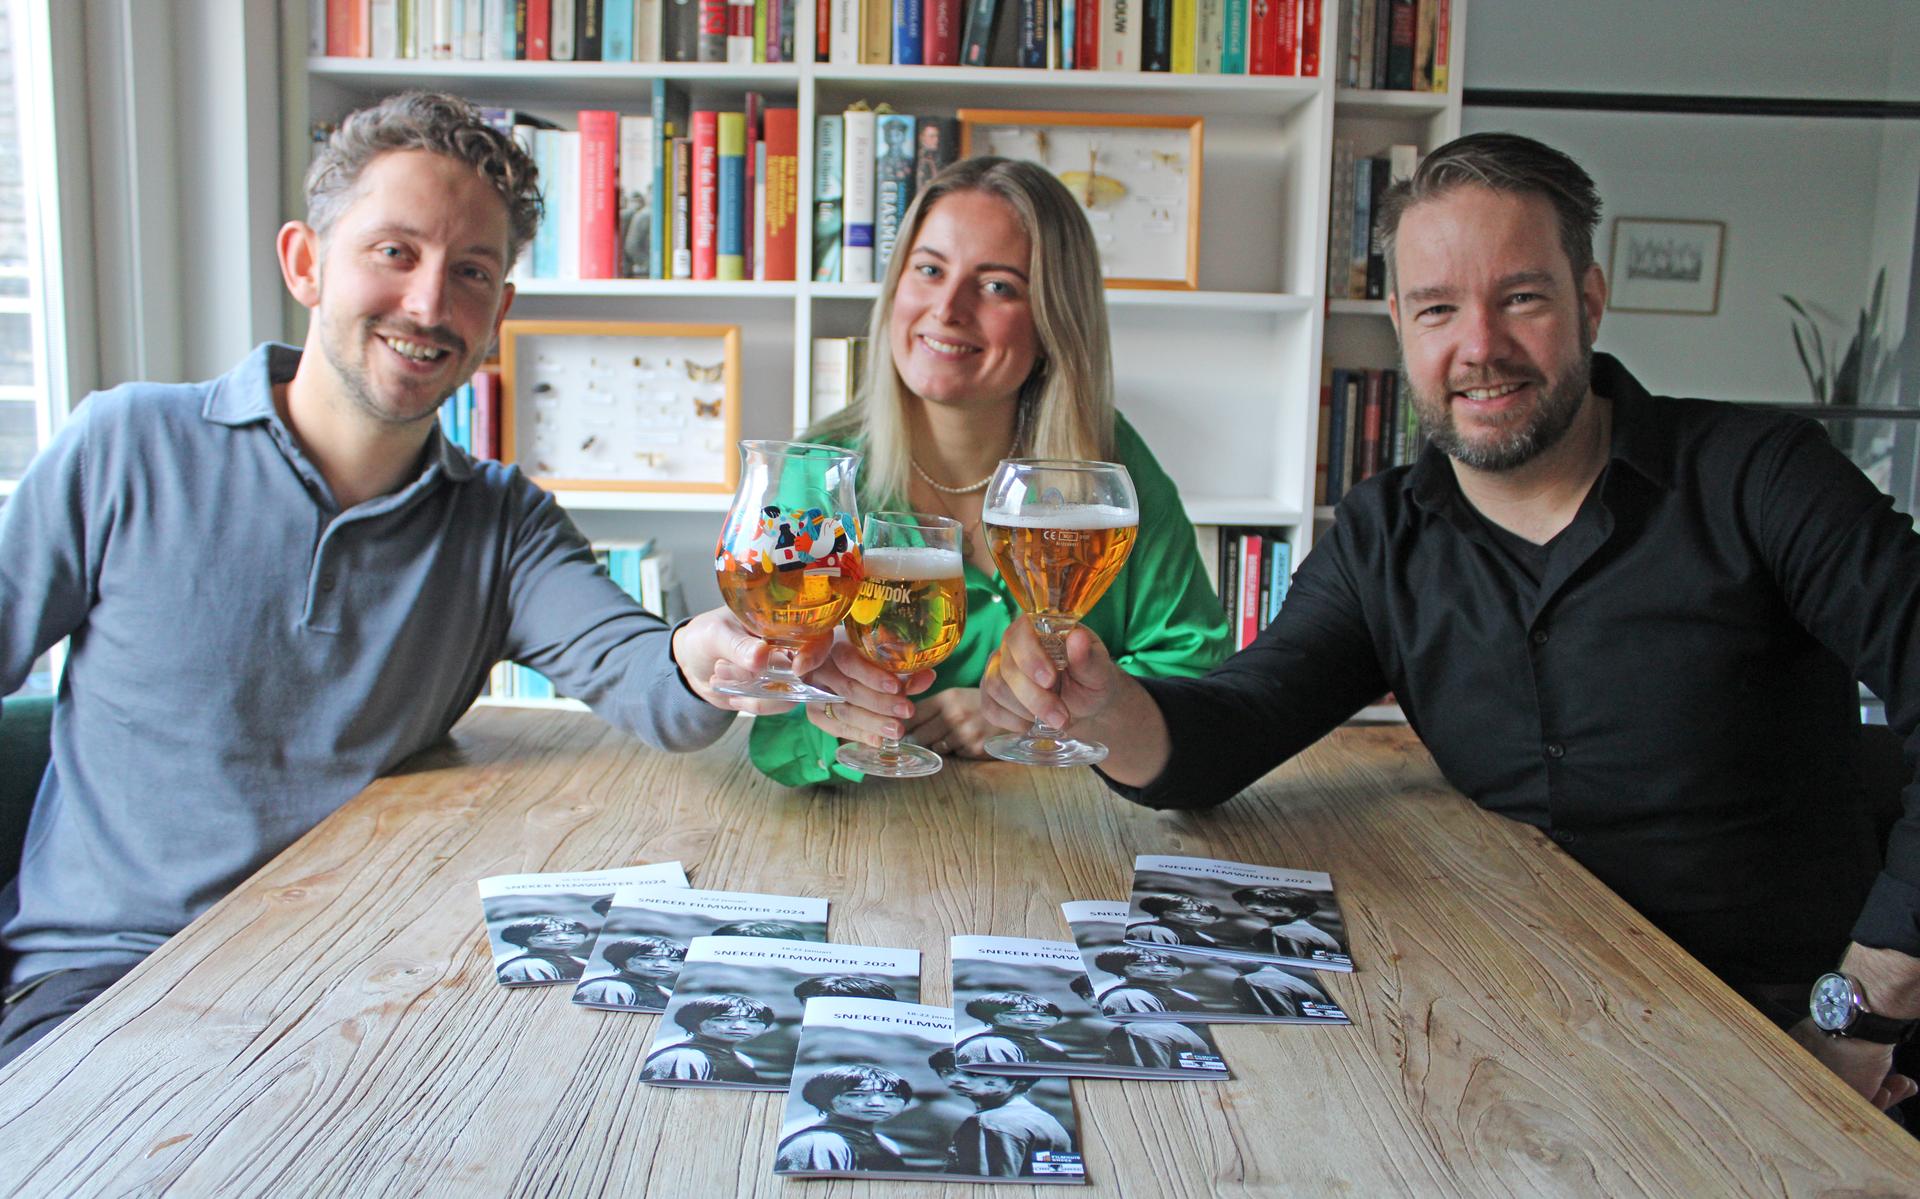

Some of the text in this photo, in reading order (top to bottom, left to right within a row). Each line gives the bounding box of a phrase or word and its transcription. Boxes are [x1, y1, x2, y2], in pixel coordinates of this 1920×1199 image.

[700, 168, 714, 185] de
[880, 180, 897, 264] ERASMUS
[860, 582, 912, 605] OUWDOK
[1157, 863, 1313, 885] SNEKER FILMWINTER 2024
[504, 878, 667, 891] SNEKER FILMWINTER 2024
[637, 897, 806, 916] SNEKER FILMWINTER 2024
[713, 950, 766, 958] SNEKER
[770, 953, 859, 966] FILMWINTER
[978, 948, 1081, 961] SNEKER FILMW
[833, 1013, 953, 1030] SNEKER FILMWI
